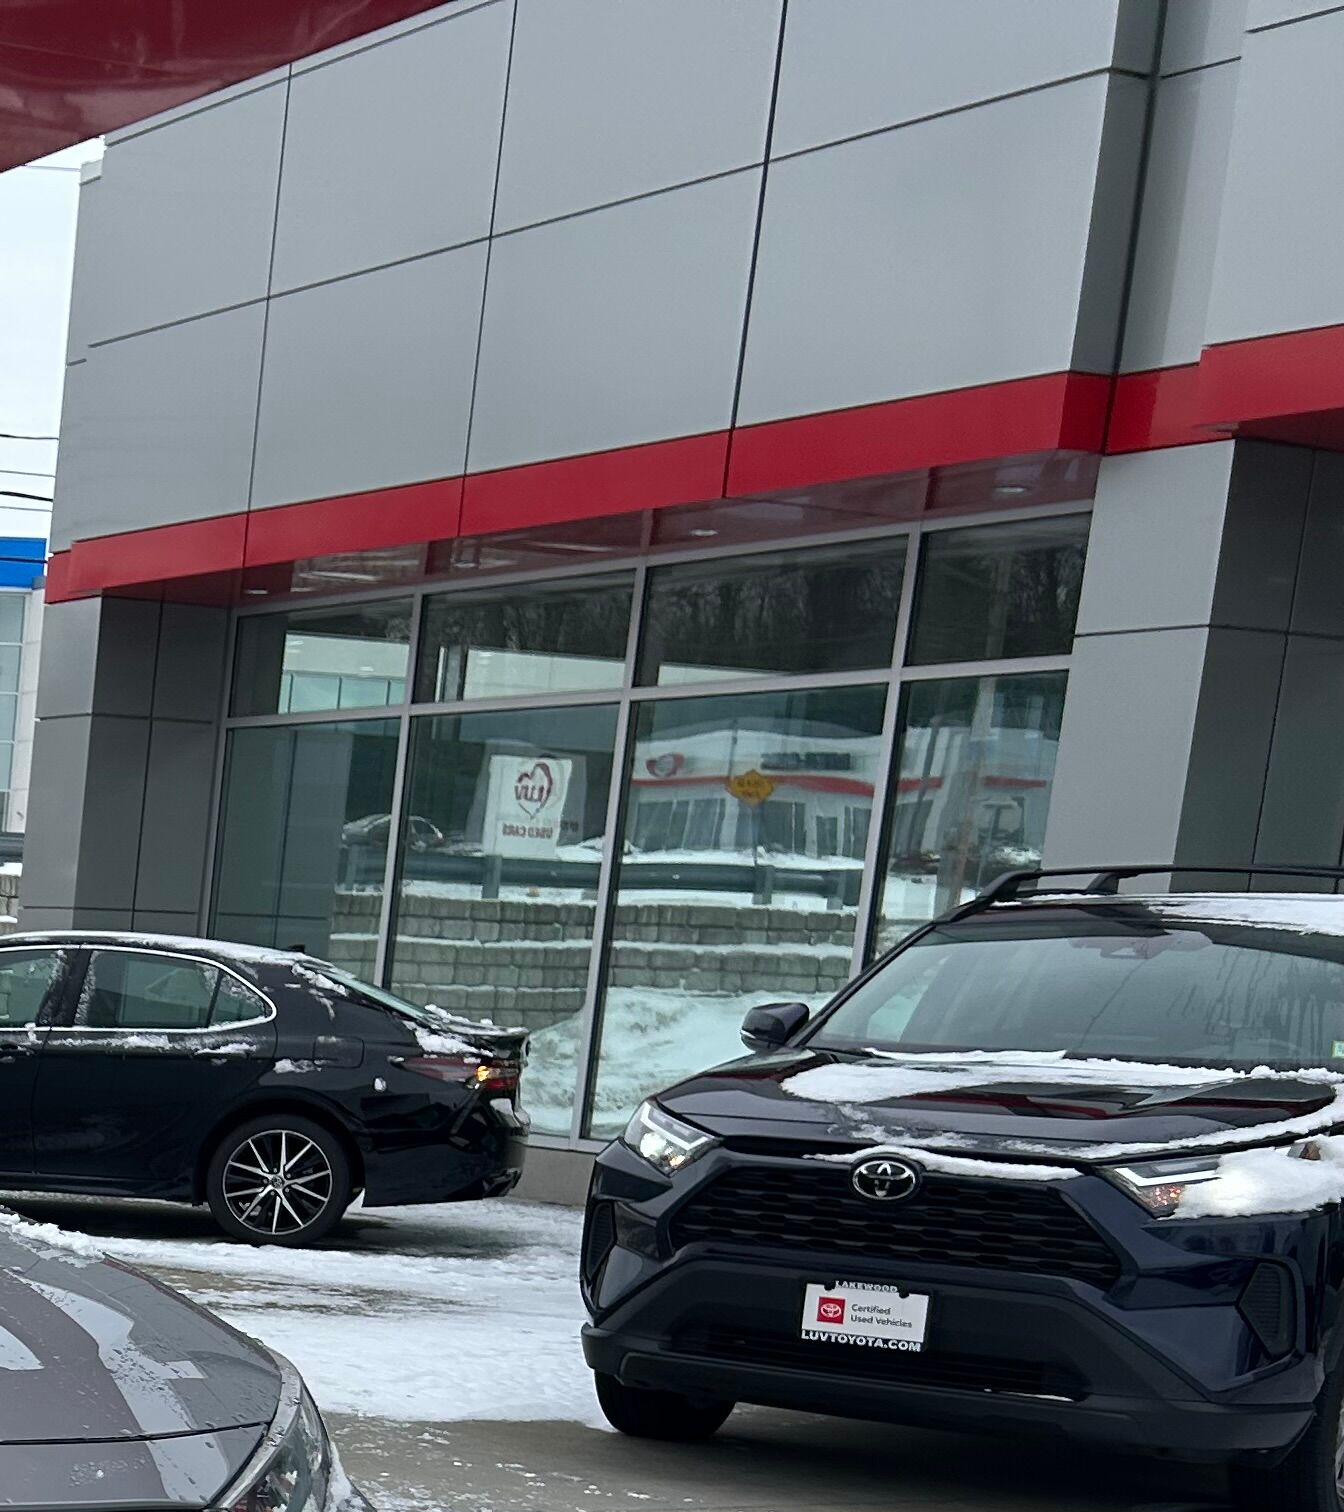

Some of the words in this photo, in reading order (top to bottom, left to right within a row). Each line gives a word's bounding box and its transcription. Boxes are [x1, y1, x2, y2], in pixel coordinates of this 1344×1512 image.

[834, 1280, 899, 1294] LAKEWOOD
[851, 1303, 892, 1316] Certified
[850, 1314, 874, 1324] Used
[875, 1316, 913, 1329] Vehicles
[800, 1329, 922, 1353] LUVTOYOTA.COM
